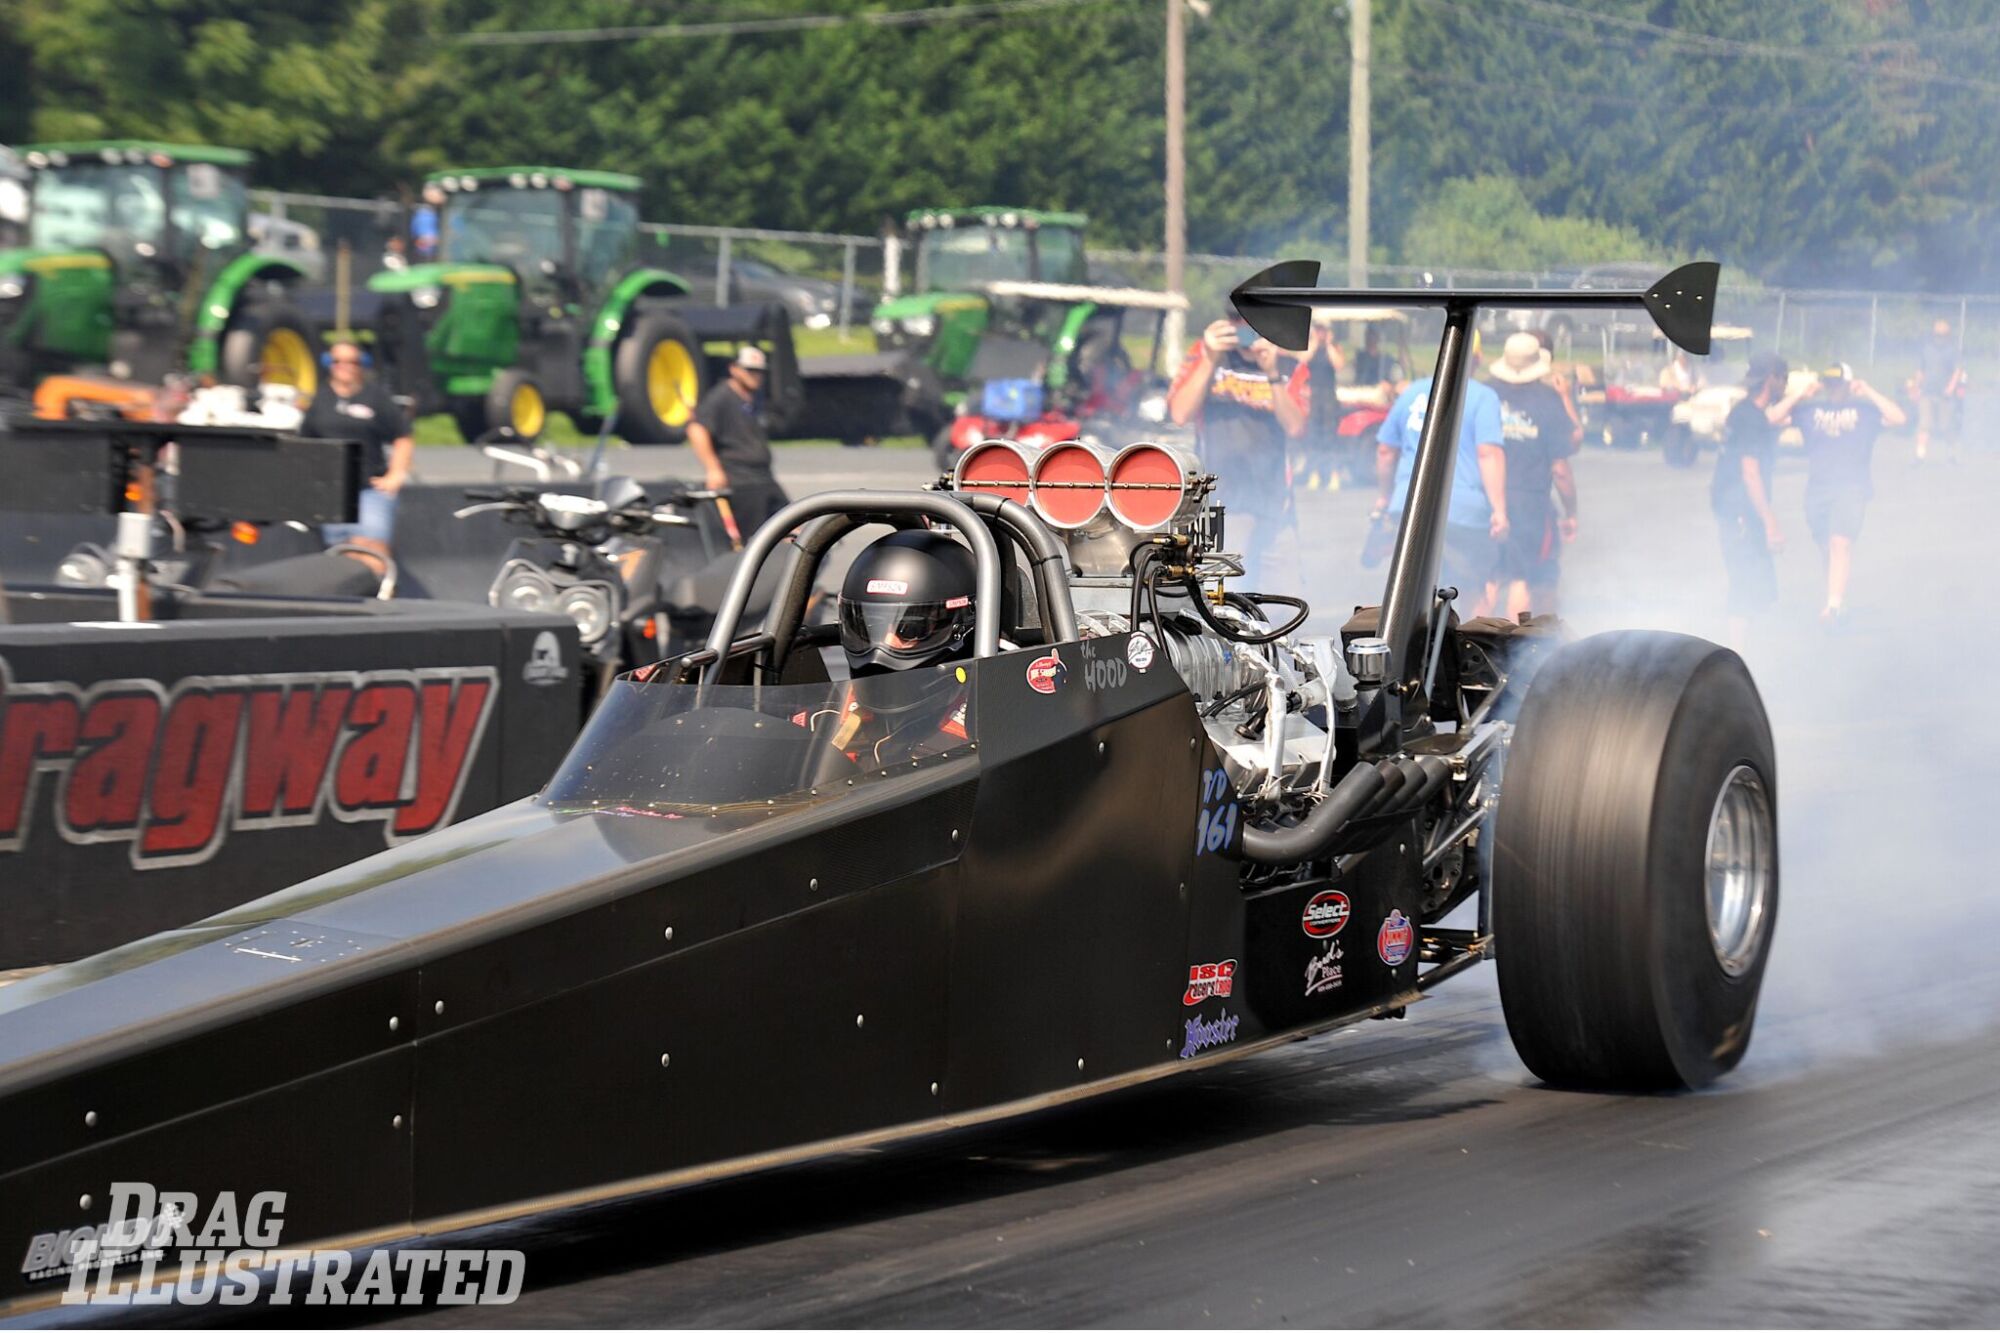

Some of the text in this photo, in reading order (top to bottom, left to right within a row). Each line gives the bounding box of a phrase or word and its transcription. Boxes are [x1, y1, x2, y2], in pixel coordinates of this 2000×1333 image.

[1084, 657, 1127, 692] HOOD
[0, 664, 499, 870] ragway
[1196, 802, 1238, 857] 161
[1303, 901, 1350, 920] Select
[1189, 962, 1235, 981] ISC
